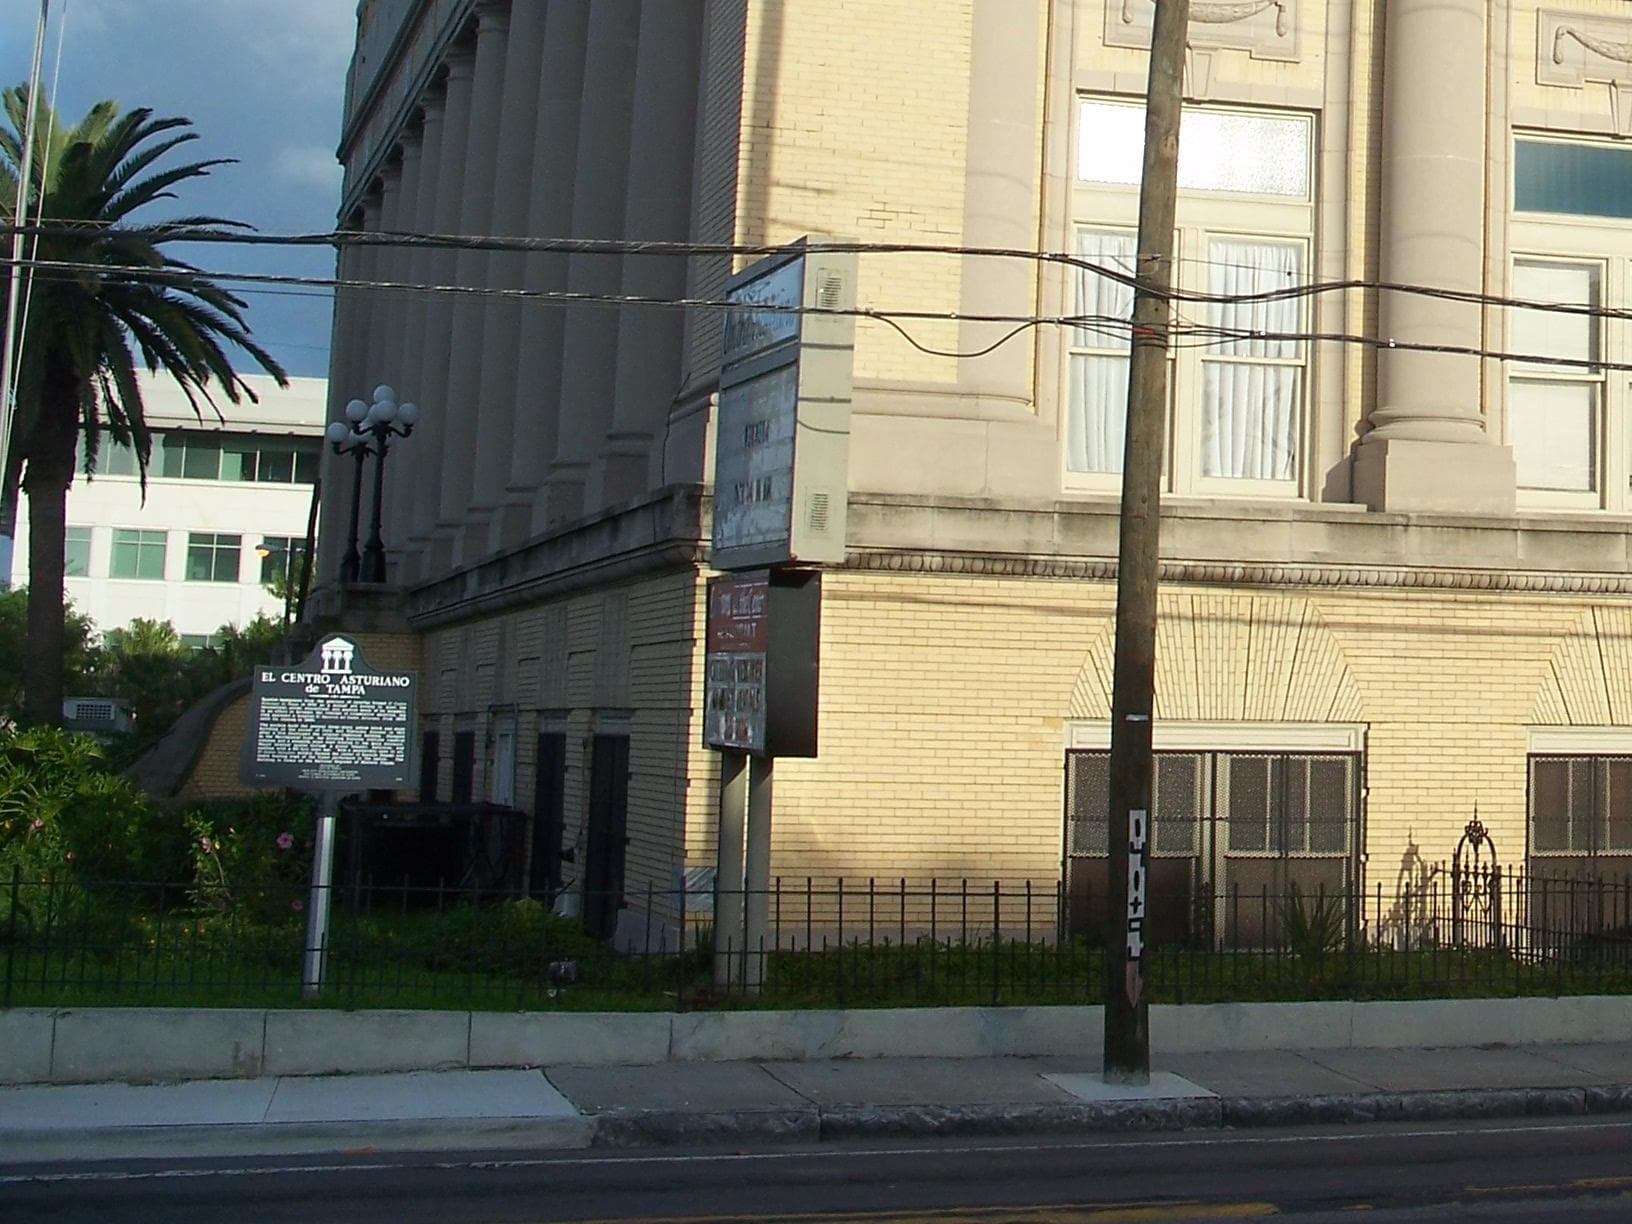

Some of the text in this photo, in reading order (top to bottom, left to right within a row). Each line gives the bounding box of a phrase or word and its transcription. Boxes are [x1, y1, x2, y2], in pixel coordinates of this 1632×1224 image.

[261, 672, 411, 688] EL CENTRO ASTURIANO
[305, 683, 366, 695] de TAMPA
